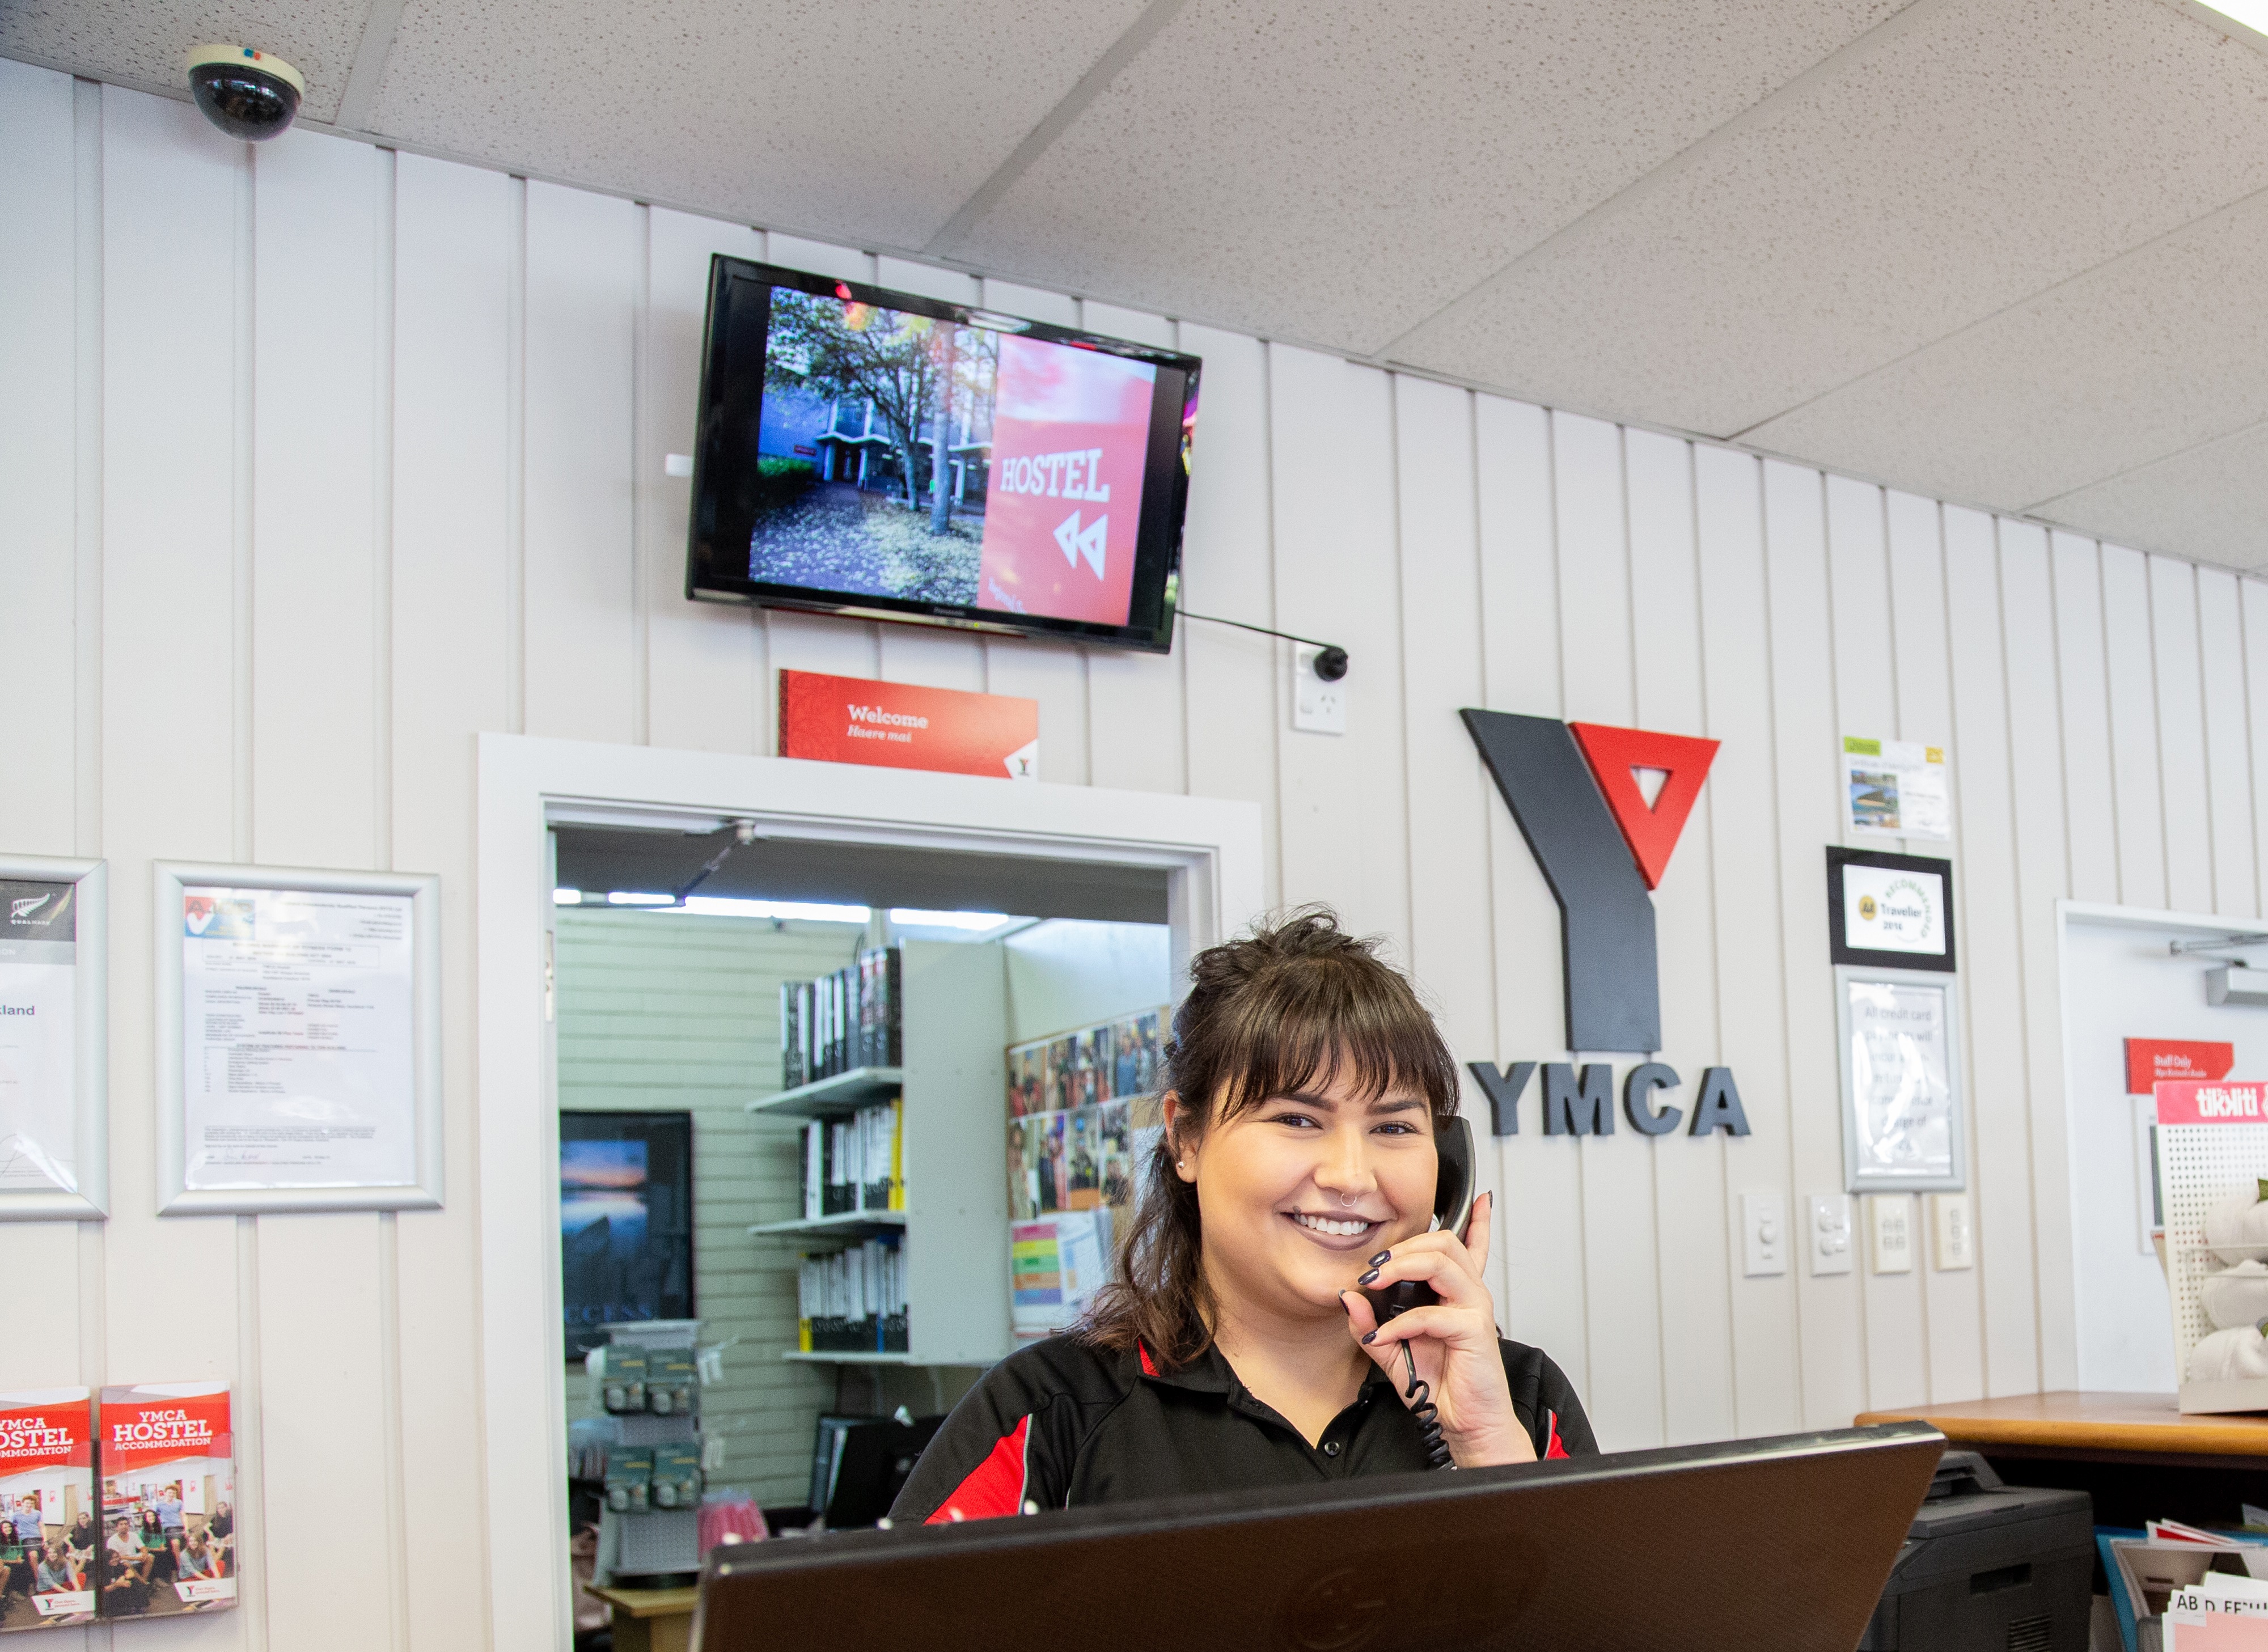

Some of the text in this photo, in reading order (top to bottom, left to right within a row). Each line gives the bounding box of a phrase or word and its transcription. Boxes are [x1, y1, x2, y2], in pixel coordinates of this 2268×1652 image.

[1000, 447, 1110, 503] HOSTEL
[847, 704, 928, 729] Welcome
[1881, 904, 1922, 917] Traveller
[0, 1005, 35, 1015] land
[1911, 1009, 1931, 1021] card
[2154, 1054, 2191, 1069] Staff Only
[1467, 1061, 1751, 1136] YMCA
[139, 1409, 187, 1422] YMCA
[0, 1417, 46, 1431] YMCA
[113, 1420, 213, 1442] HOSTEL
[115, 1438, 211, 1451] ACCOMMODATION
[0, 1446, 72, 1458] MMODATION
[2177, 1594, 2198, 1611] AB
